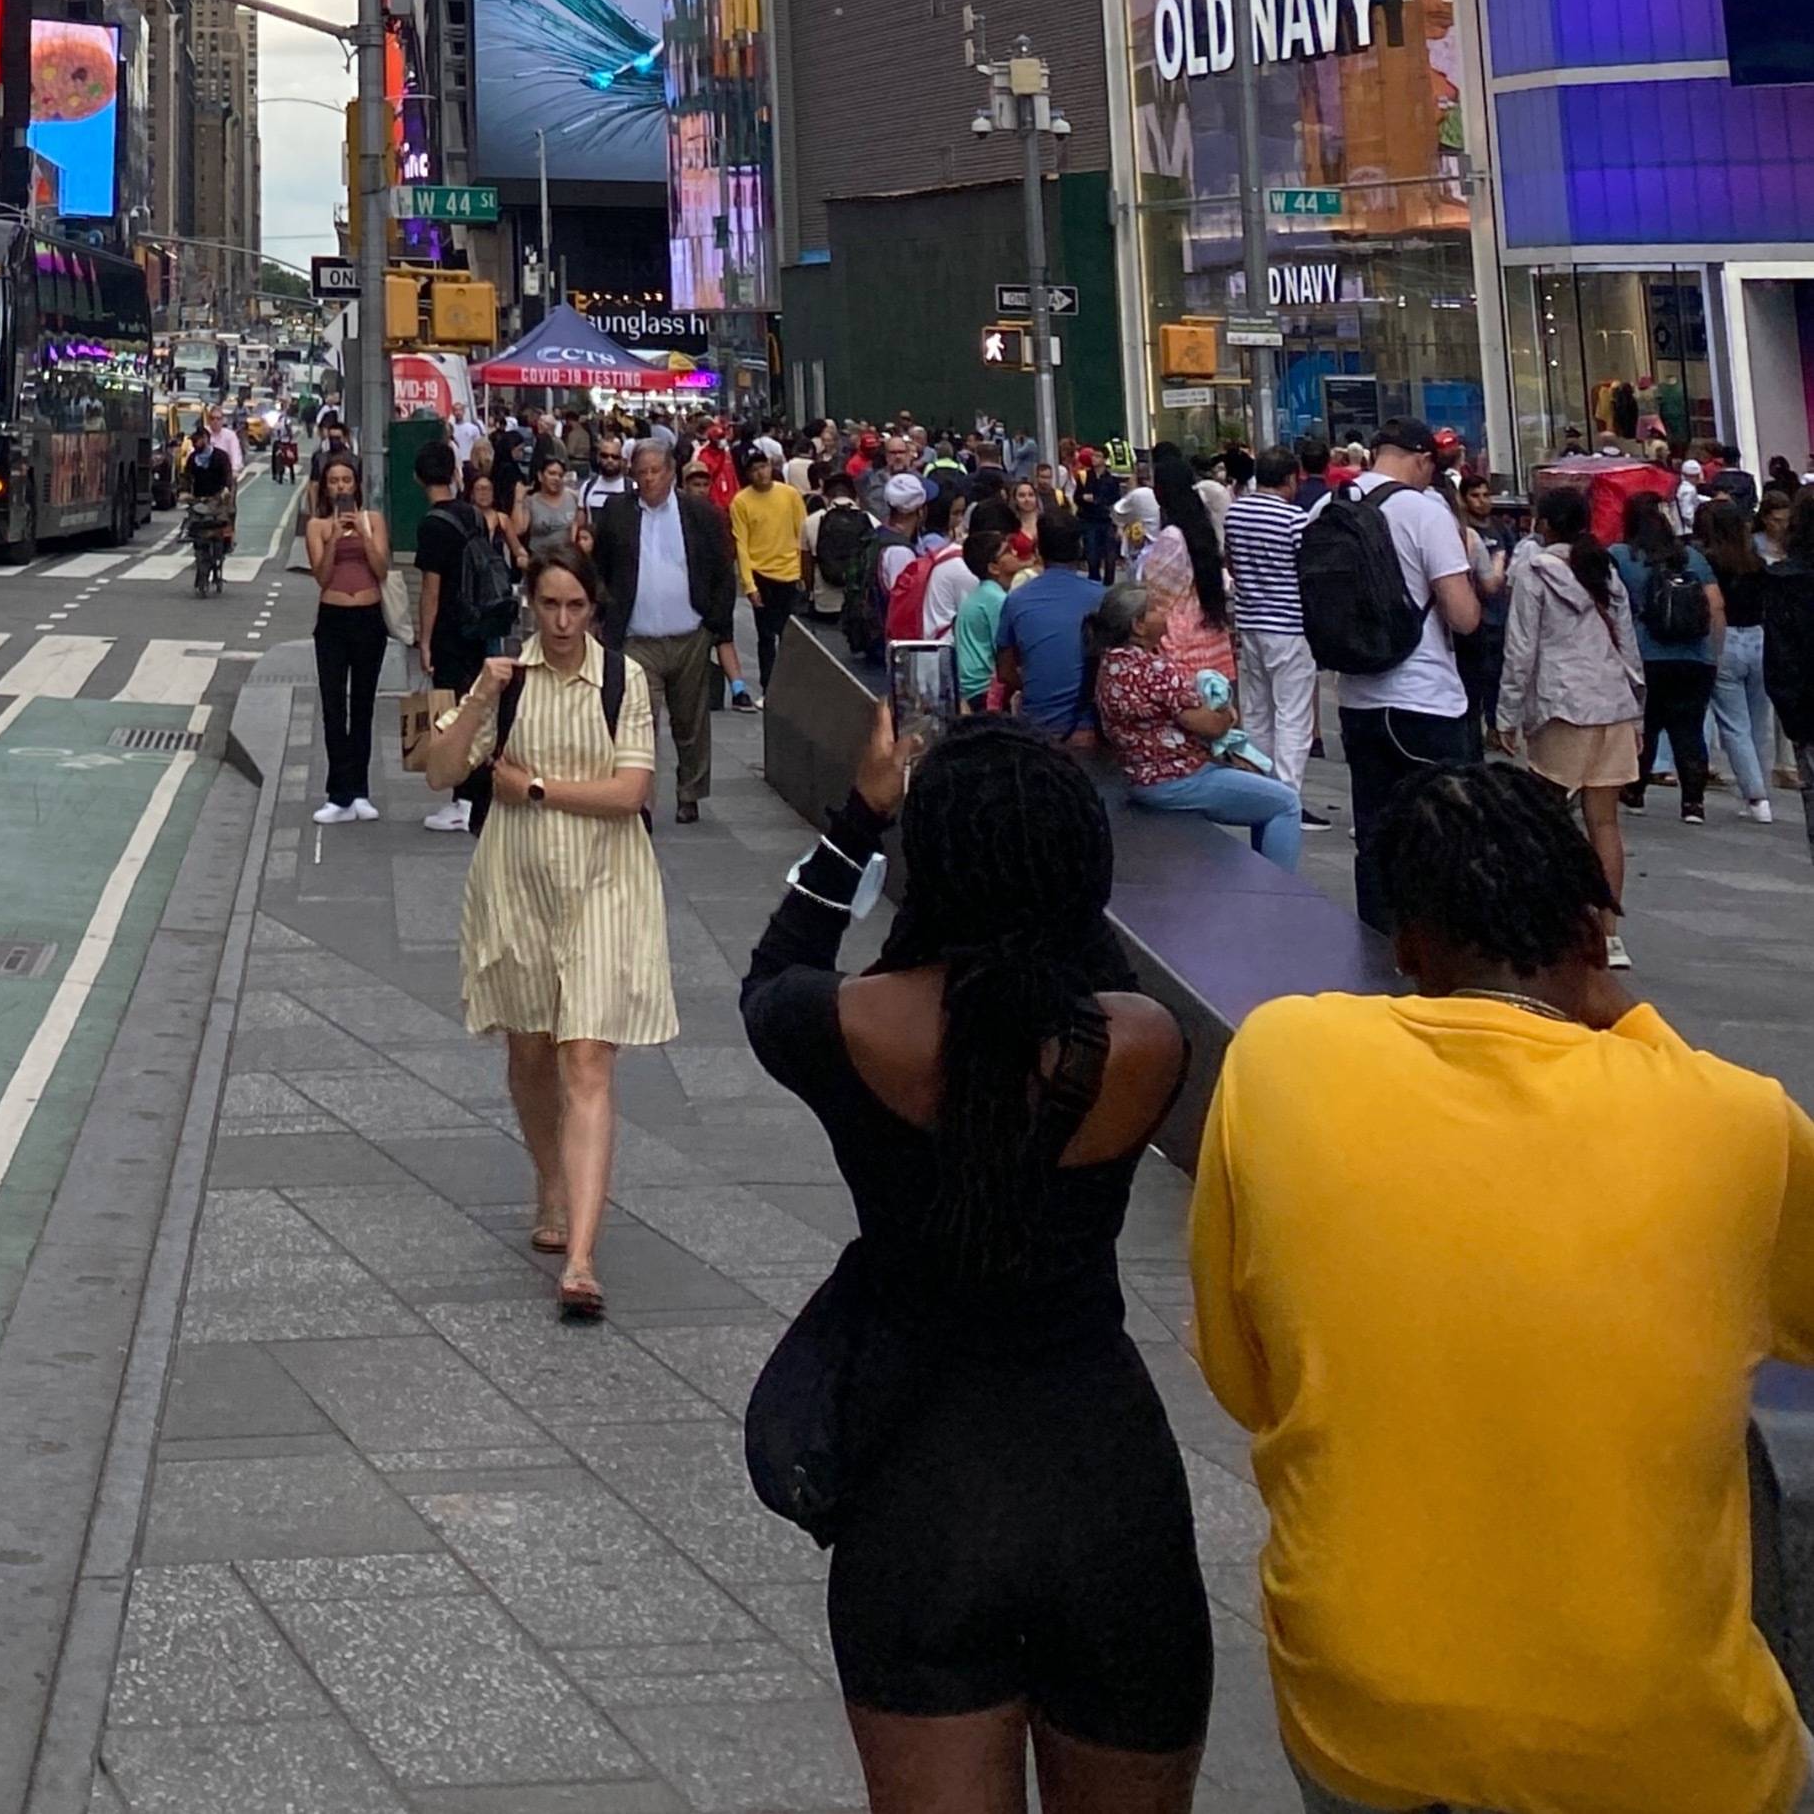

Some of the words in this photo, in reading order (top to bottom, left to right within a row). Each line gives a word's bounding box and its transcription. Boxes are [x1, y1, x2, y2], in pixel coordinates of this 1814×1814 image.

[417, 192, 435, 214] W
[445, 192, 471, 216] 44
[1271, 192, 1287, 212] W
[1294, 193, 1318, 213] 44
[1287, 264, 1337, 305] NAVY
[521, 367, 582, 385] COVID-19
[586, 369, 642, 386] TESTING
[393, 380, 439, 398] VID-19
